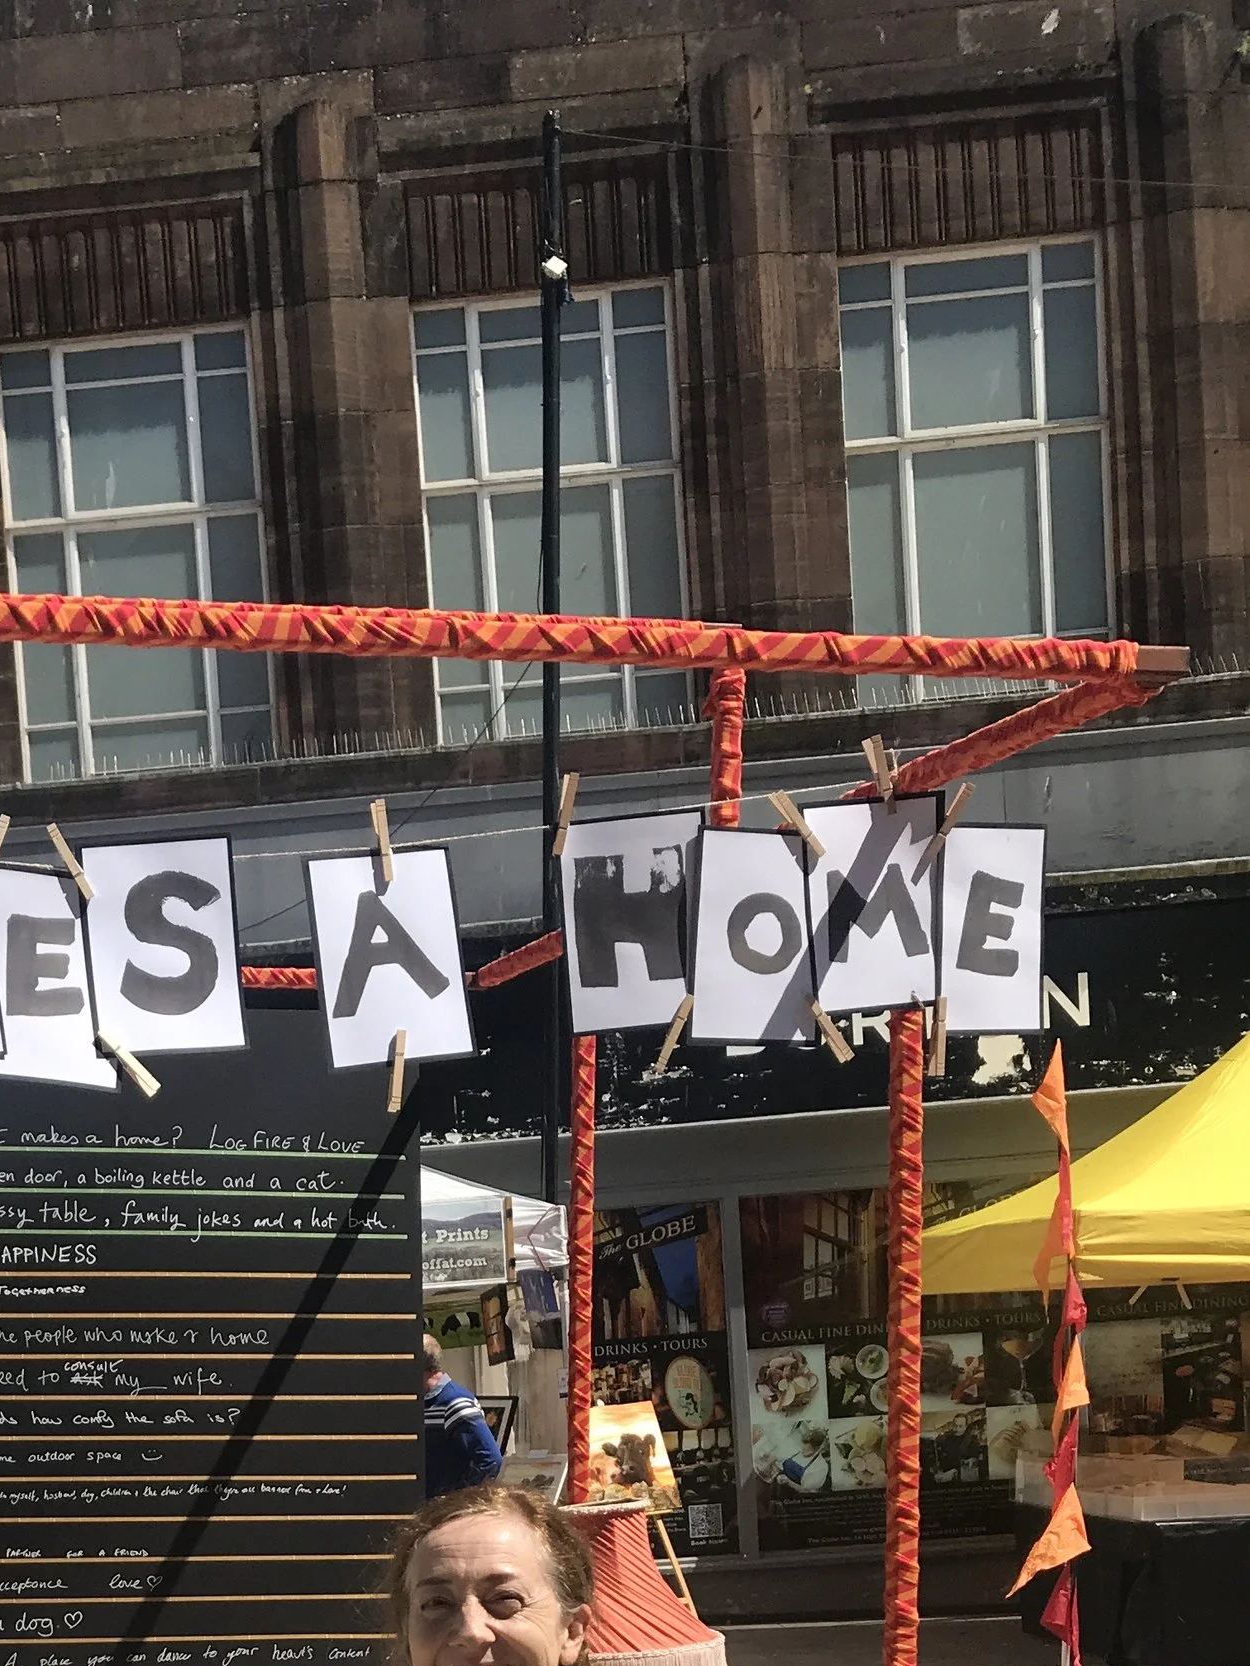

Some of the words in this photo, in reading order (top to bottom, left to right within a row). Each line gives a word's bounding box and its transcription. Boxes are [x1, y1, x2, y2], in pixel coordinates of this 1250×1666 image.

[332, 890, 450, 1018] A
[573, 845, 1025, 989] HOME
[21, 1125, 79, 1145] makes
[86, 1132, 102, 1145] a
[115, 1124, 183, 1148] home?
[209, 1124, 248, 1151] LOG
[253, 1131, 295, 1149] FIRE
[318, 1131, 366, 1153] LOVE
[24, 1168, 68, 1188] door,
[77, 1174, 87, 1185] a
[95, 1168, 145, 1188] boiling
[152, 1169, 207, 1186] kettle
[222, 1173, 254, 1189] and
[269, 1177, 281, 1190] a
[295, 1170, 345, 1191] cat.
[120, 1200, 187, 1230] family
[190, 1207, 242, 1243] jokes
[253, 1211, 284, 1229] and
[293, 1218, 302, 1230] a
[311, 1206, 338, 1229] hot
[436, 1227, 489, 1244] Prints
[626, 1215, 696, 1250] GLOBE
[422, 1256, 488, 1271] offat.com
[24, 1325, 78, 1348] people
[84, 1326, 123, 1343] who
[130, 1326, 179, 1345] make
[210, 1326, 270, 1347] home
[761, 1328, 815, 1343] CASUAL
[819, 1325, 852, 1340] FINE
[856, 1323, 887, 1336] DIN
[594, 1342, 649, 1358] DRINKS
[661, 1337, 709, 1351] TOURS
[37, 1370, 60, 1386] to
[64, 1359, 124, 1373] consult
[31, 1410, 63, 1425] how
[73, 1409, 115, 1428] comfy
[125, 1411, 154, 1425] the
[163, 1409, 195, 1425] sofa
[207, 1408, 241, 1426] is?
[28, 1451, 76, 1463] outdoor
[86, 1451, 122, 1464] space
[142, 1485, 158, 1497] the
[108, 1574, 144, 1590] love
[126, 1653, 147, 1663] can
[156, 1647, 192, 1663] dance
[203, 1645, 217, 1660] to
[222, 1646, 260, 1666] your
[328, 1646, 371, 1660] content
